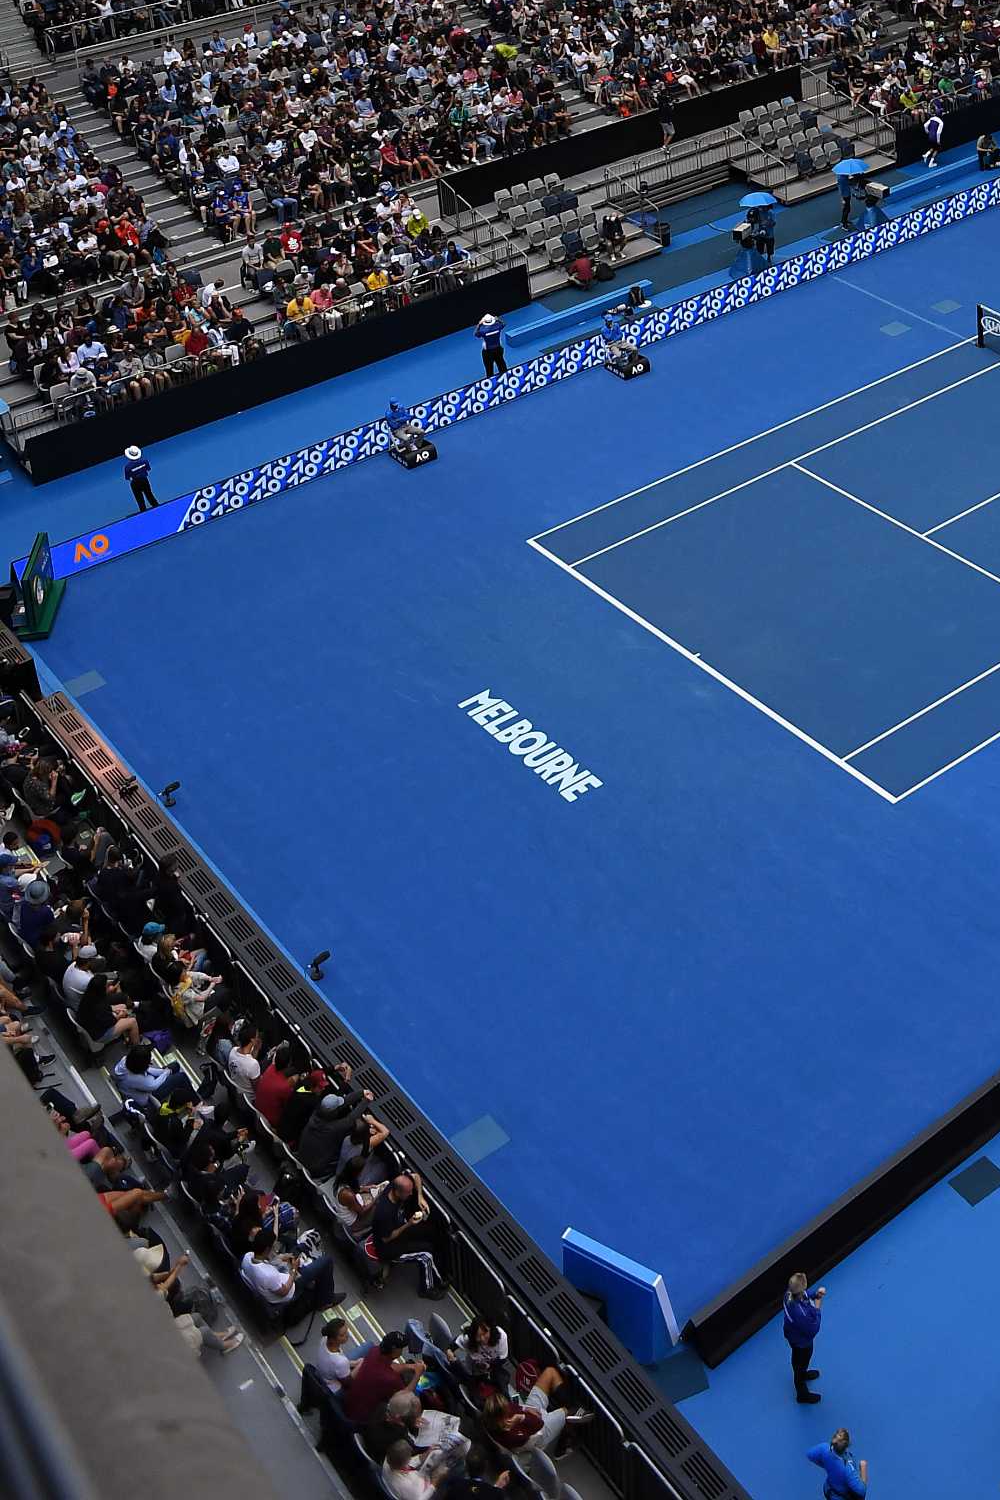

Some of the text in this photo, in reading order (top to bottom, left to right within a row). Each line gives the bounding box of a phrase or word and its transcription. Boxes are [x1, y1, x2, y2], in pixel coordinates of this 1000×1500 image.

[631, 363, 644, 375] AO
[415, 450, 430, 463] AO
[74, 534, 109, 563] AO
[457, 688, 604, 803] MELBOURNE
